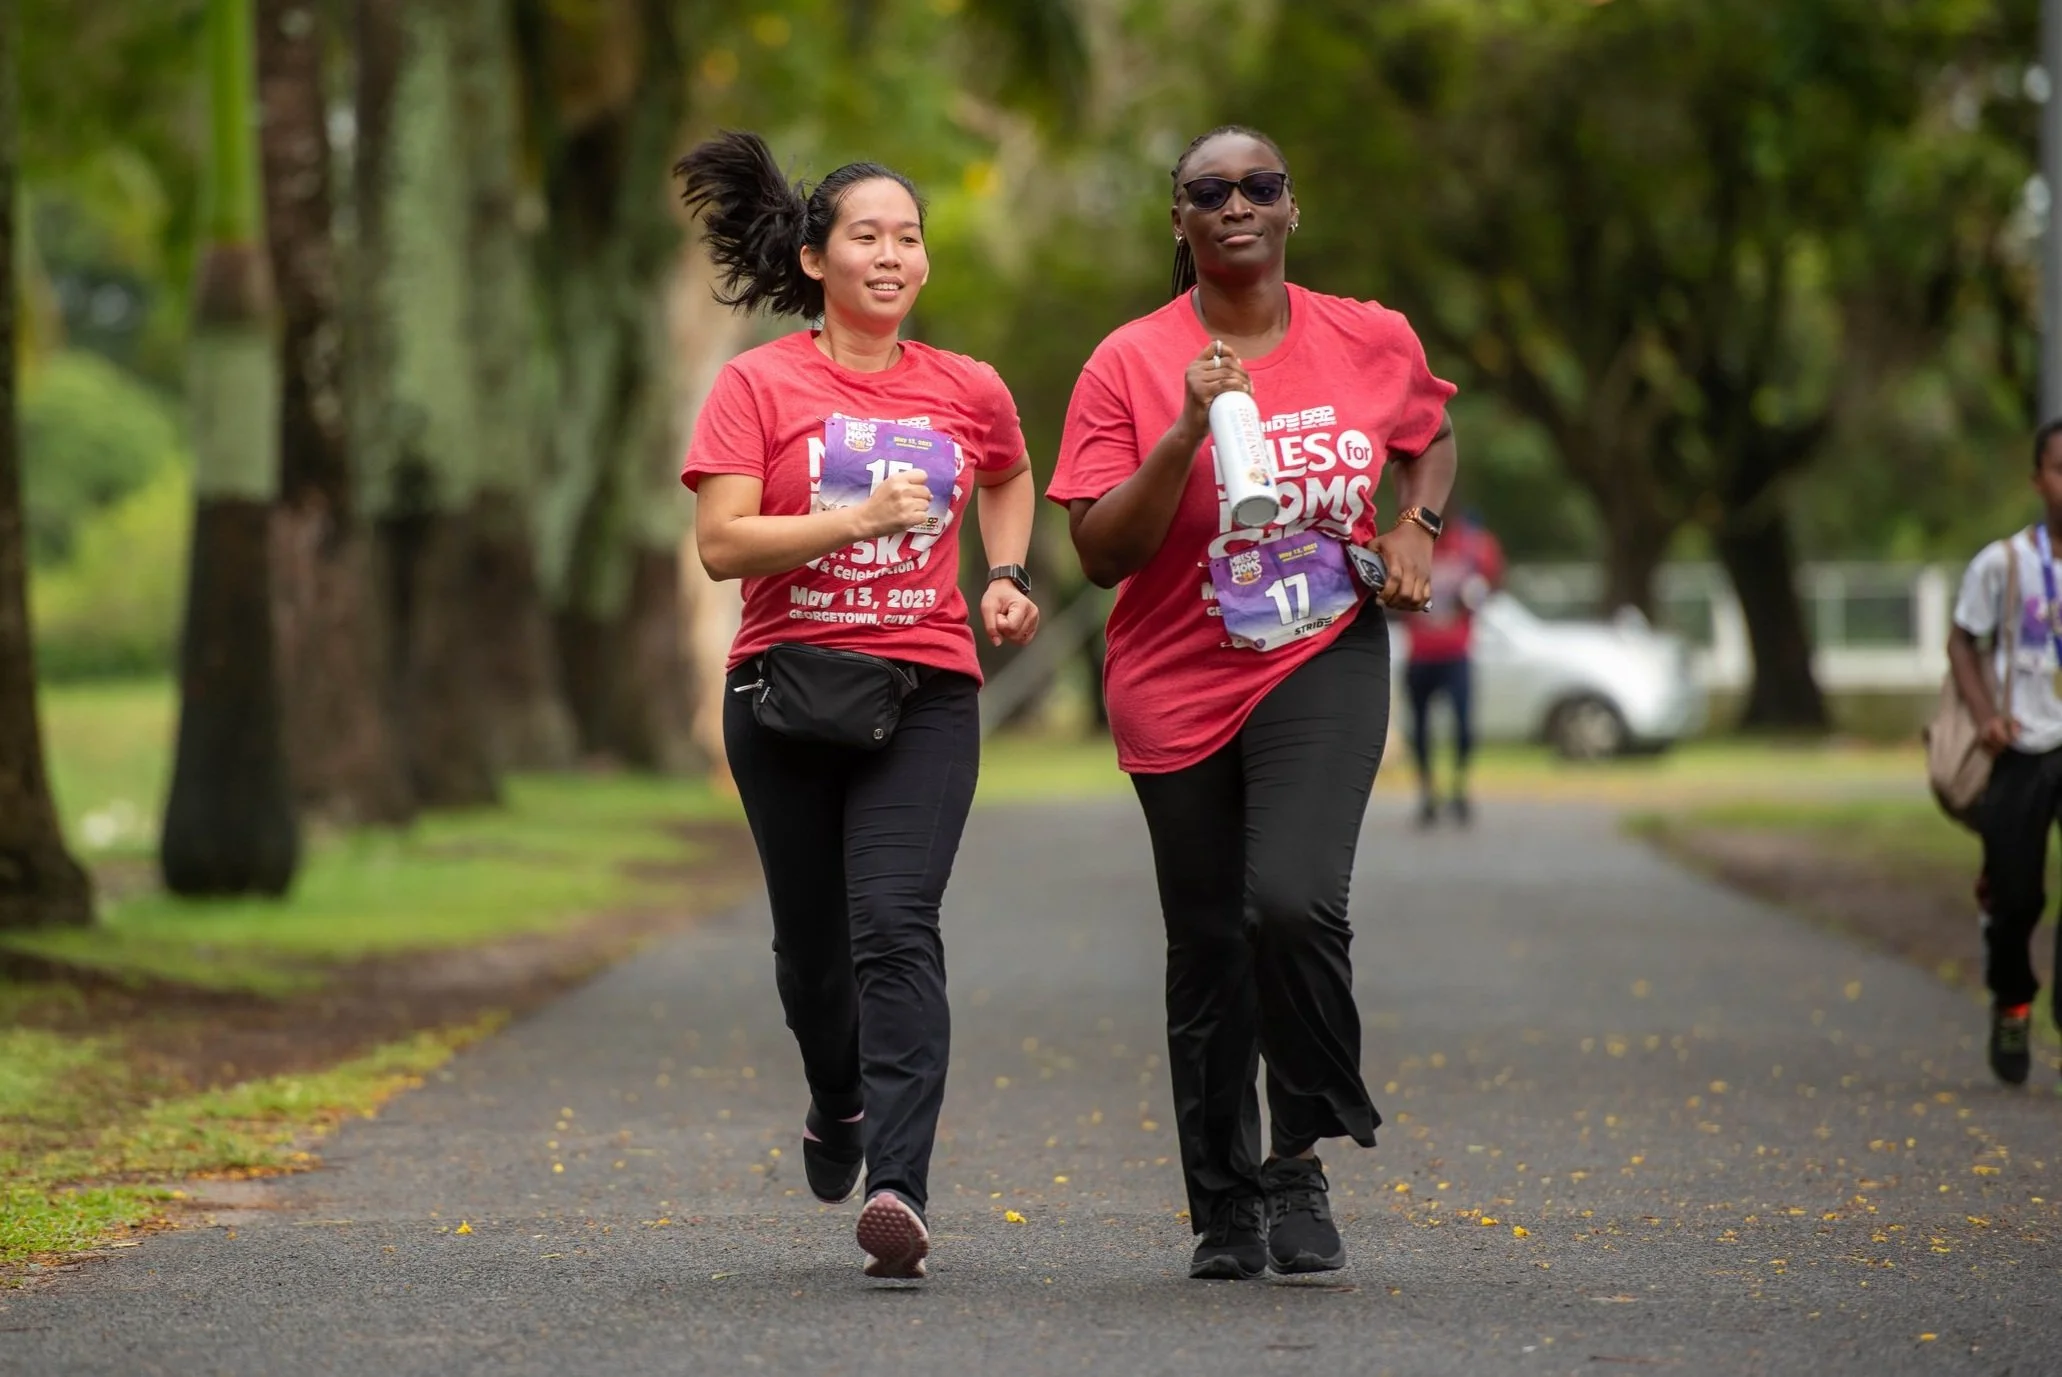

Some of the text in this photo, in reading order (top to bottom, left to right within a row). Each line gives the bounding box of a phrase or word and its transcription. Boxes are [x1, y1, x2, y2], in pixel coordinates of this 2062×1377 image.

[1260, 412, 1300, 432] RIDE
[1344, 440, 1370, 462] for
[1218, 475, 1371, 538] OMS
[820, 560, 831, 574] &
[790, 585, 937, 609] May 13, 2023
[1265, 572, 1310, 626] 17
[789, 609, 921, 626] GEORGETOWN, GUYA
[1294, 616, 1332, 635] STRIDE
